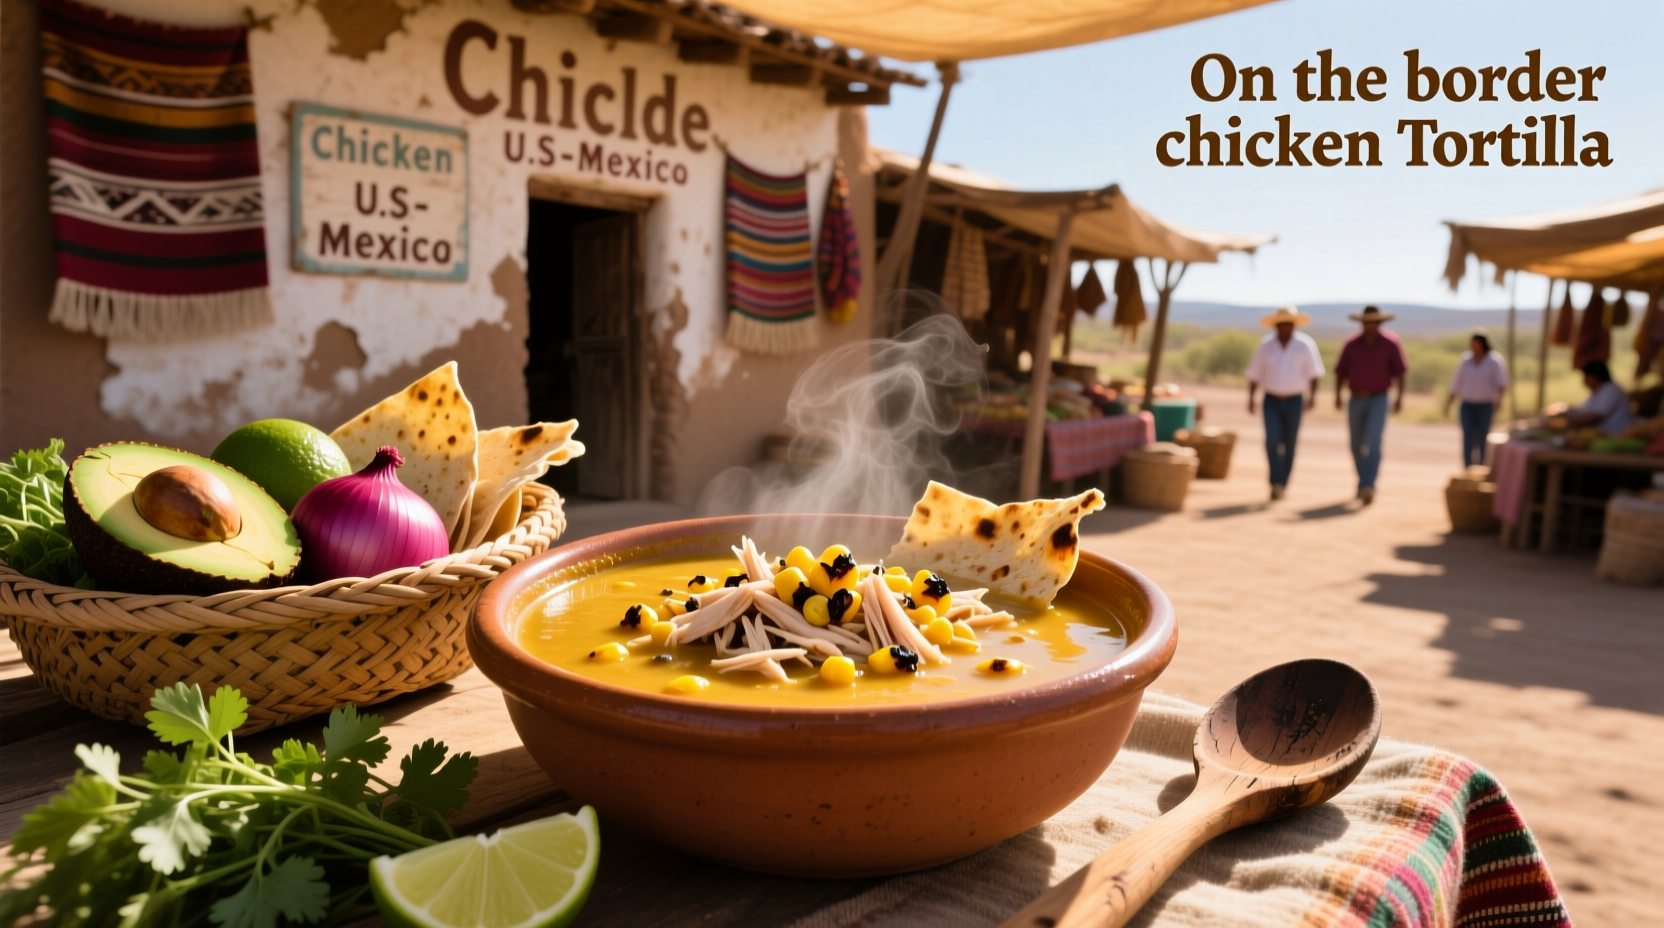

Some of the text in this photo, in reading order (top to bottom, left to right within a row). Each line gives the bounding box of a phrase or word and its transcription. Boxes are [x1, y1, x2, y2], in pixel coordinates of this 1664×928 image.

[444, 19, 710, 153] Chiclde
[311, 125, 453, 174] Chicken
[504, 131, 689, 186] U.S-Mexico
[355, 181, 429, 219] U.S-
[318, 220, 453, 265] Mexico
